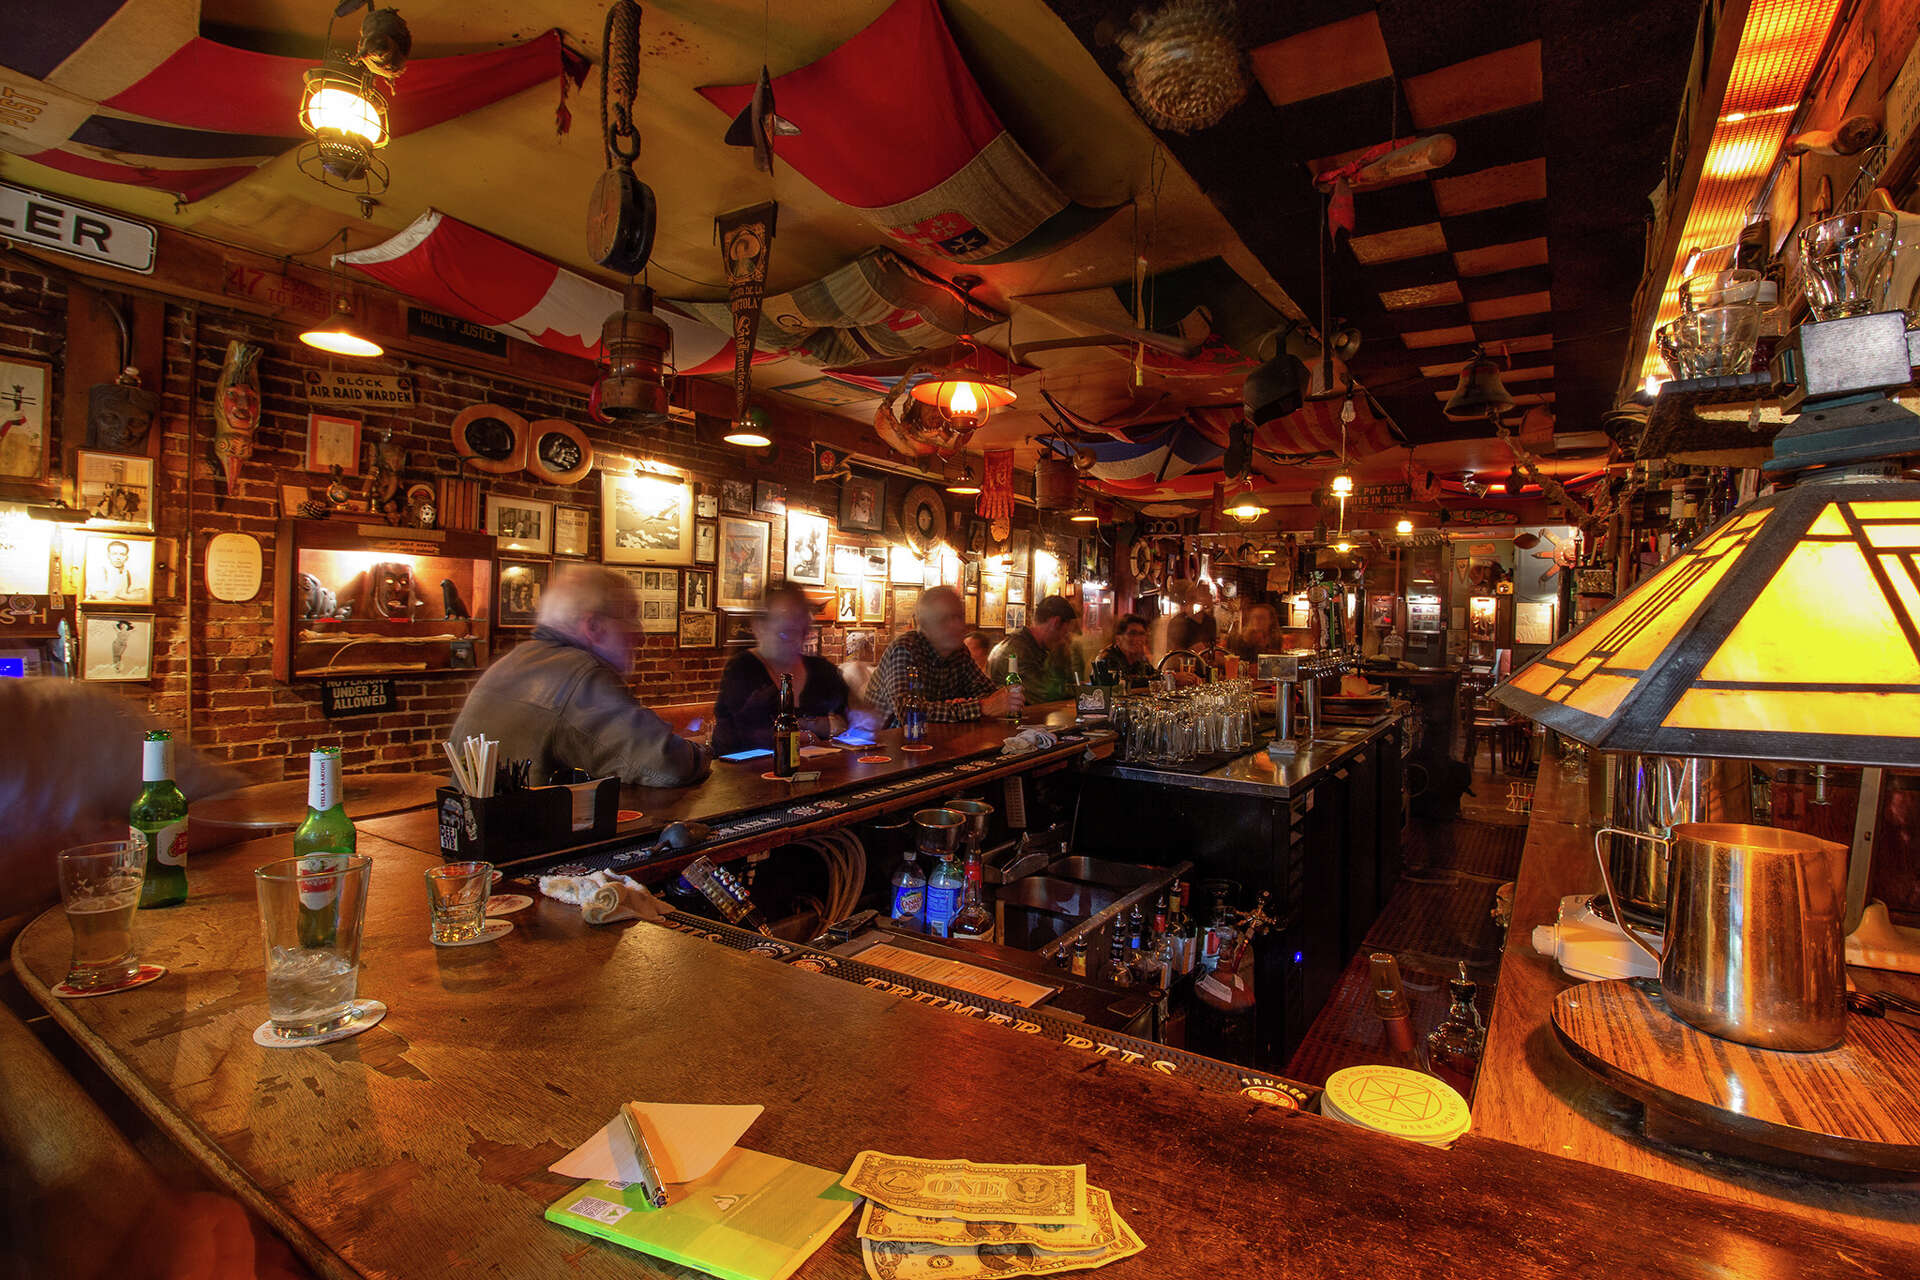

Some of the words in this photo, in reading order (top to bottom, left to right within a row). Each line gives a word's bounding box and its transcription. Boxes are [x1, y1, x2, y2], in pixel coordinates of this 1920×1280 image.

[420, 311, 444, 329] HALL
[460, 323, 496, 343] JUSTICE
[336, 377, 383, 388] BLOCK
[310, 386, 330, 398] AIR
[333, 387, 361, 400] RAID
[364, 389, 411, 403] WARDEN
[332, 685, 369, 698] UNDER
[371, 684, 385, 695] 21
[333, 695, 387, 711] ALLOWED
[1241, 1077, 1308, 1100] TRUMER
[927, 1176, 1004, 1198] ONE
